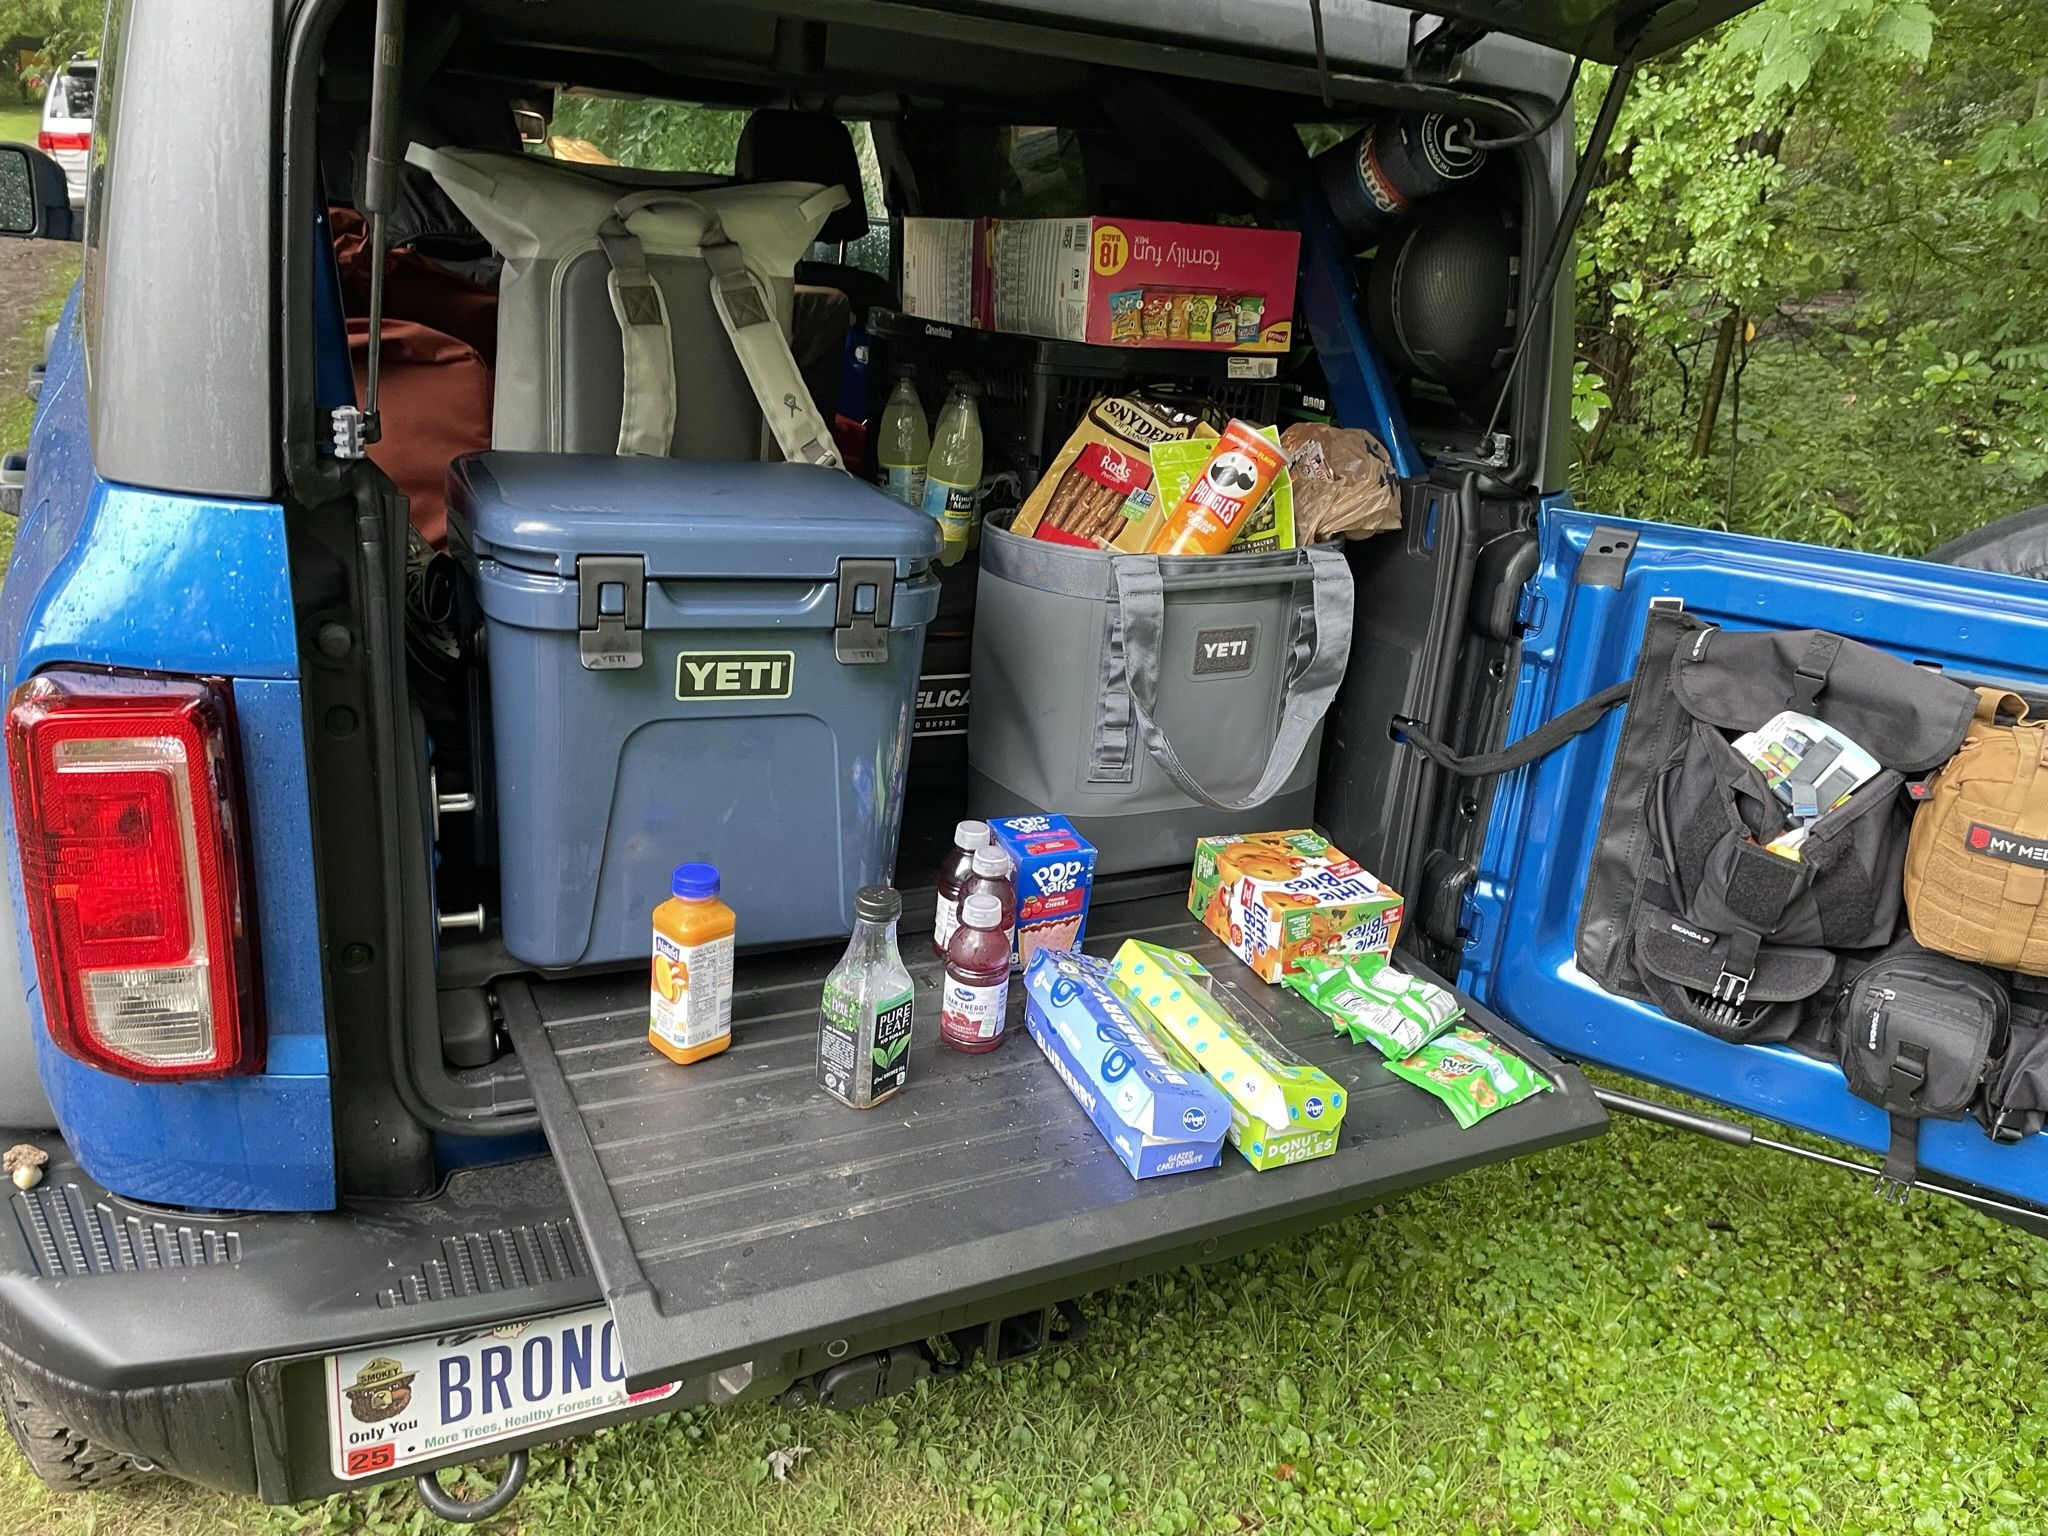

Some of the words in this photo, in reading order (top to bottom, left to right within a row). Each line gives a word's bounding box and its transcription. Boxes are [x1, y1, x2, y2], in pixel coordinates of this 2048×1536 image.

[1101, 233, 1121, 243] BAGS
[1134, 236, 1149, 244] MIX
[1100, 242, 1121, 268] 18
[1133, 244, 1163, 267] fun
[1166, 242, 1221, 270] family
[1188, 478, 1242, 525] PRINGLES
[600, 654, 626, 663] YETI
[1204, 640, 1247, 659] YETI
[685, 661, 783, 691] YETI
[916, 689, 970, 709] ELICA
[1990, 837, 2017, 853] MY
[1284, 872, 1341, 893] Bites
[1323, 877, 1375, 903] Little
[1045, 900, 1069, 909] CHERRY
[1243, 908, 1254, 964] Bites
[1253, 901, 1268, 956] Little
[1346, 916, 1382, 940] Bites
[1355, 924, 1390, 951] Little
[880, 1003, 912, 1027] PURE
[880, 1037, 888, 1045] NO
[889, 1030, 905, 1041] SUGAR
[1036, 1030, 1097, 1113] BLUEBERRY
[1246, 1082, 1256, 1092] NO
[1184, 1112, 1206, 1127] Kroger
[1305, 1101, 1324, 1115] Kroger
[1268, 1132, 1320, 1158] DONUT
[1285, 1139, 1333, 1165] HOLES
[1156, 1161, 1175, 1172] CAKE
[1176, 1154, 1203, 1168] DONUTS
[1168, 1151, 1194, 1163] GLAZED
[361, 1367, 400, 1384] SMOKEY
[439, 1320, 626, 1426] BRONC
[349, 1427, 385, 1444] Only
[389, 1419, 418, 1434] You
[424, 1432, 459, 1449] More
[462, 1423, 501, 1439] Trees,
[505, 1408, 554, 1428] Healthy
[557, 1394, 604, 1415] Forests
[351, 1448, 390, 1471] 25
